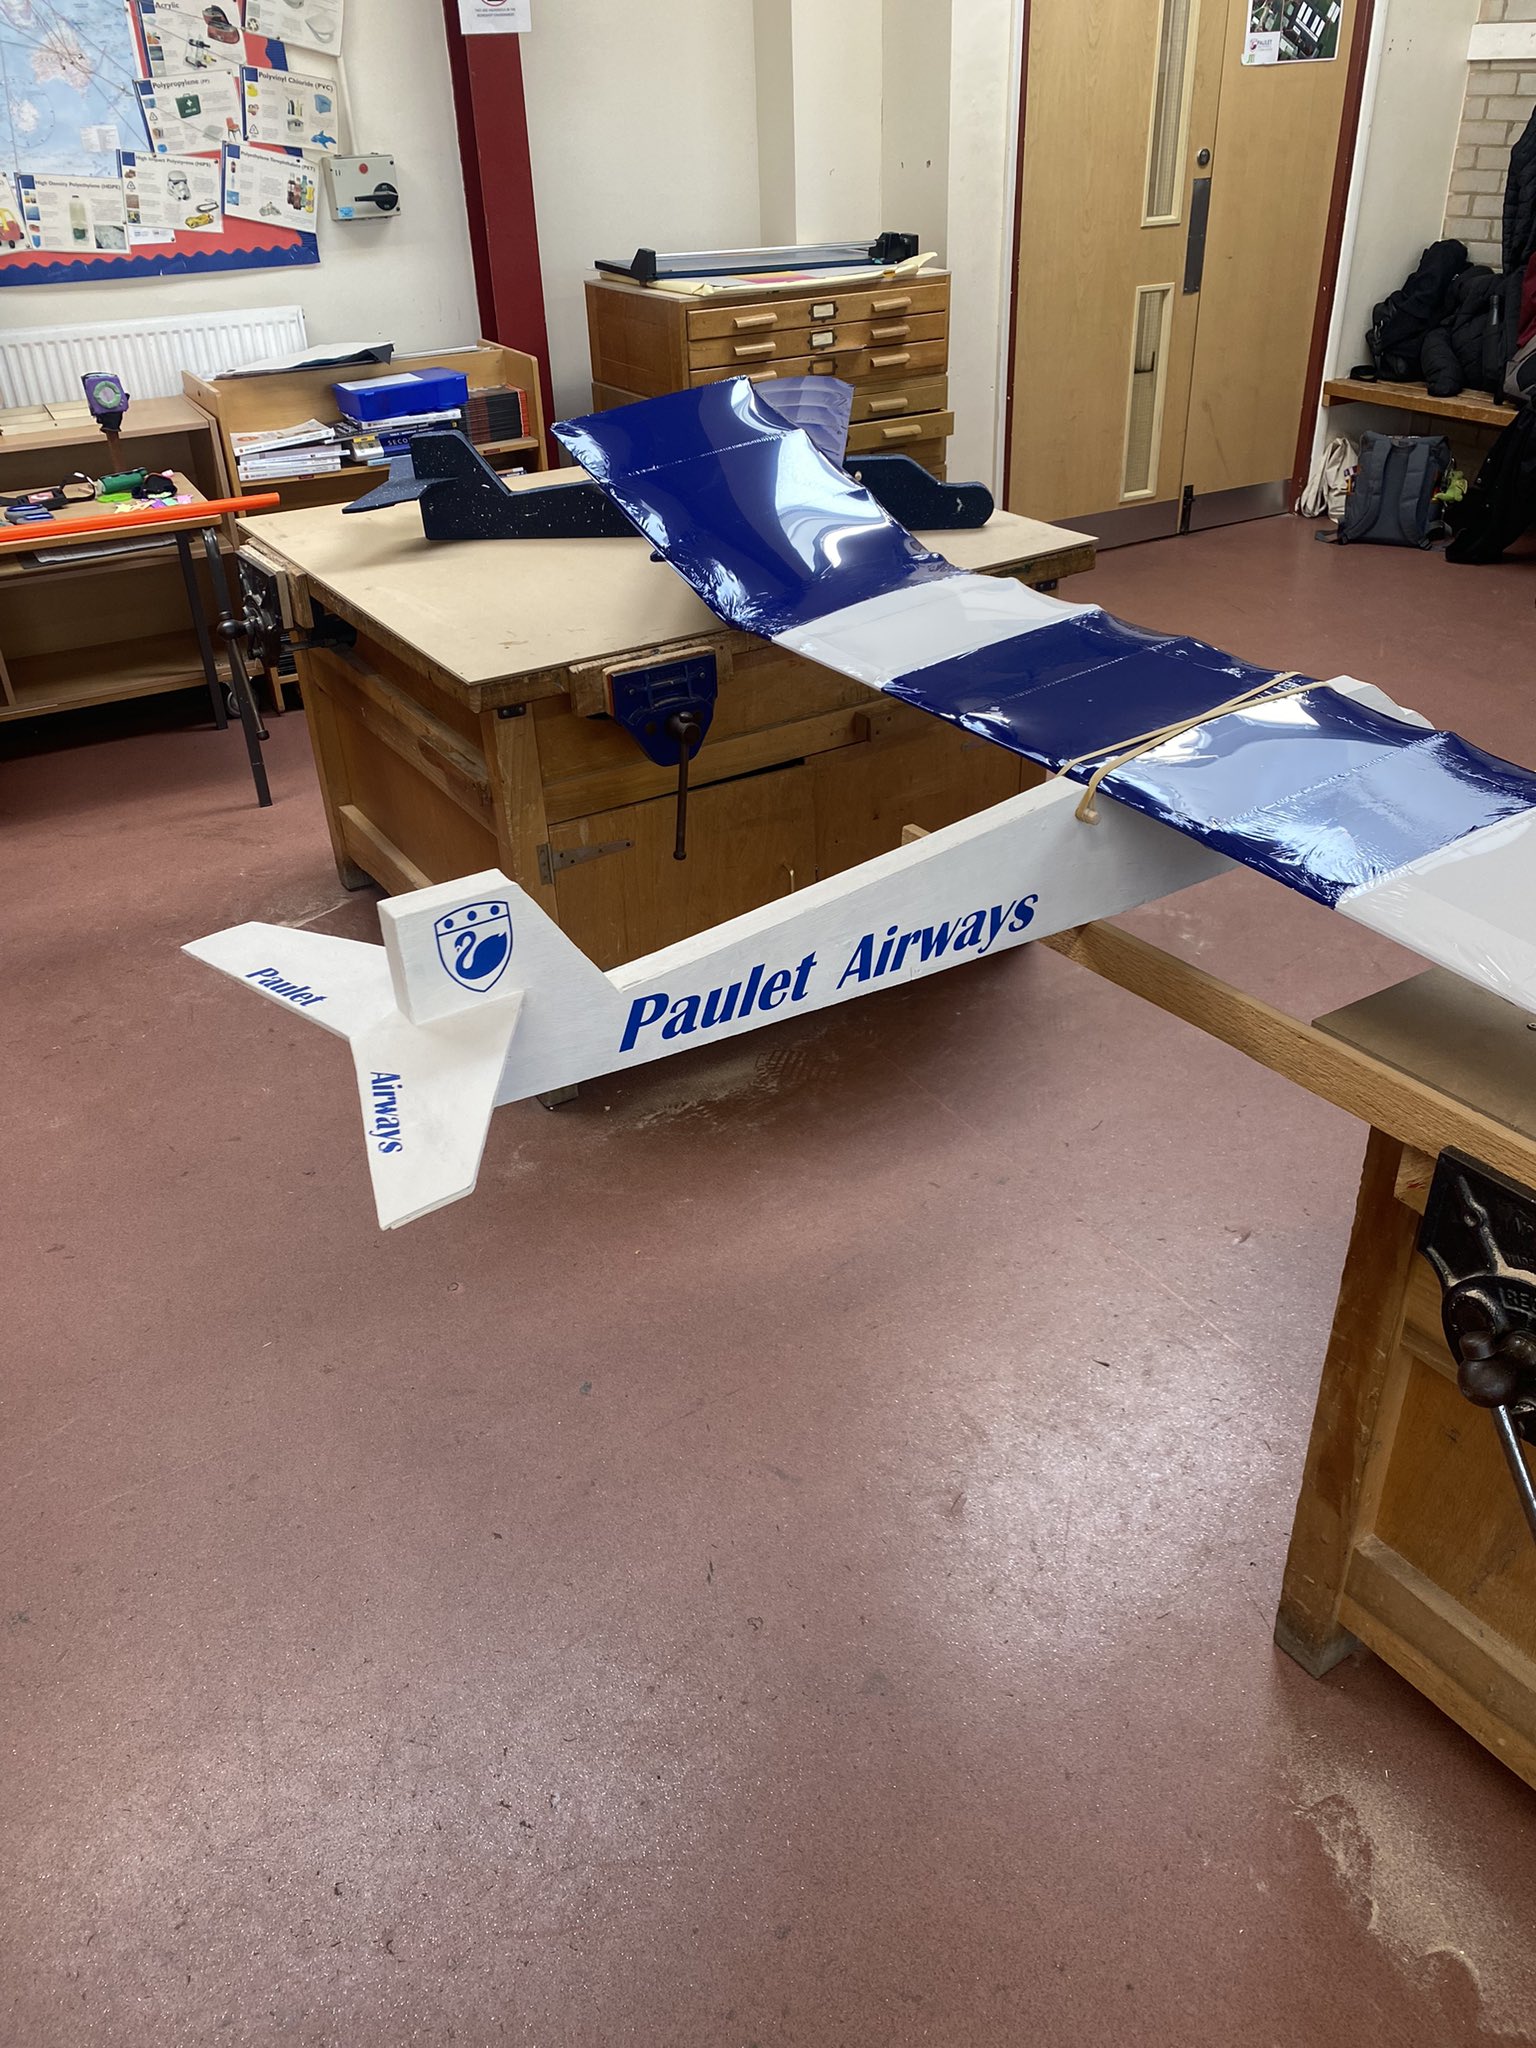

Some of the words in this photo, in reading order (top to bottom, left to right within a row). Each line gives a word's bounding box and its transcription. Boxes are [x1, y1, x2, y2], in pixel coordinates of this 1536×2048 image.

[246, 967, 327, 1006] Paulet
[619, 952, 816, 1052] Paulet
[836, 893, 1038, 989] Airways
[369, 1072, 403, 1153] Airways
